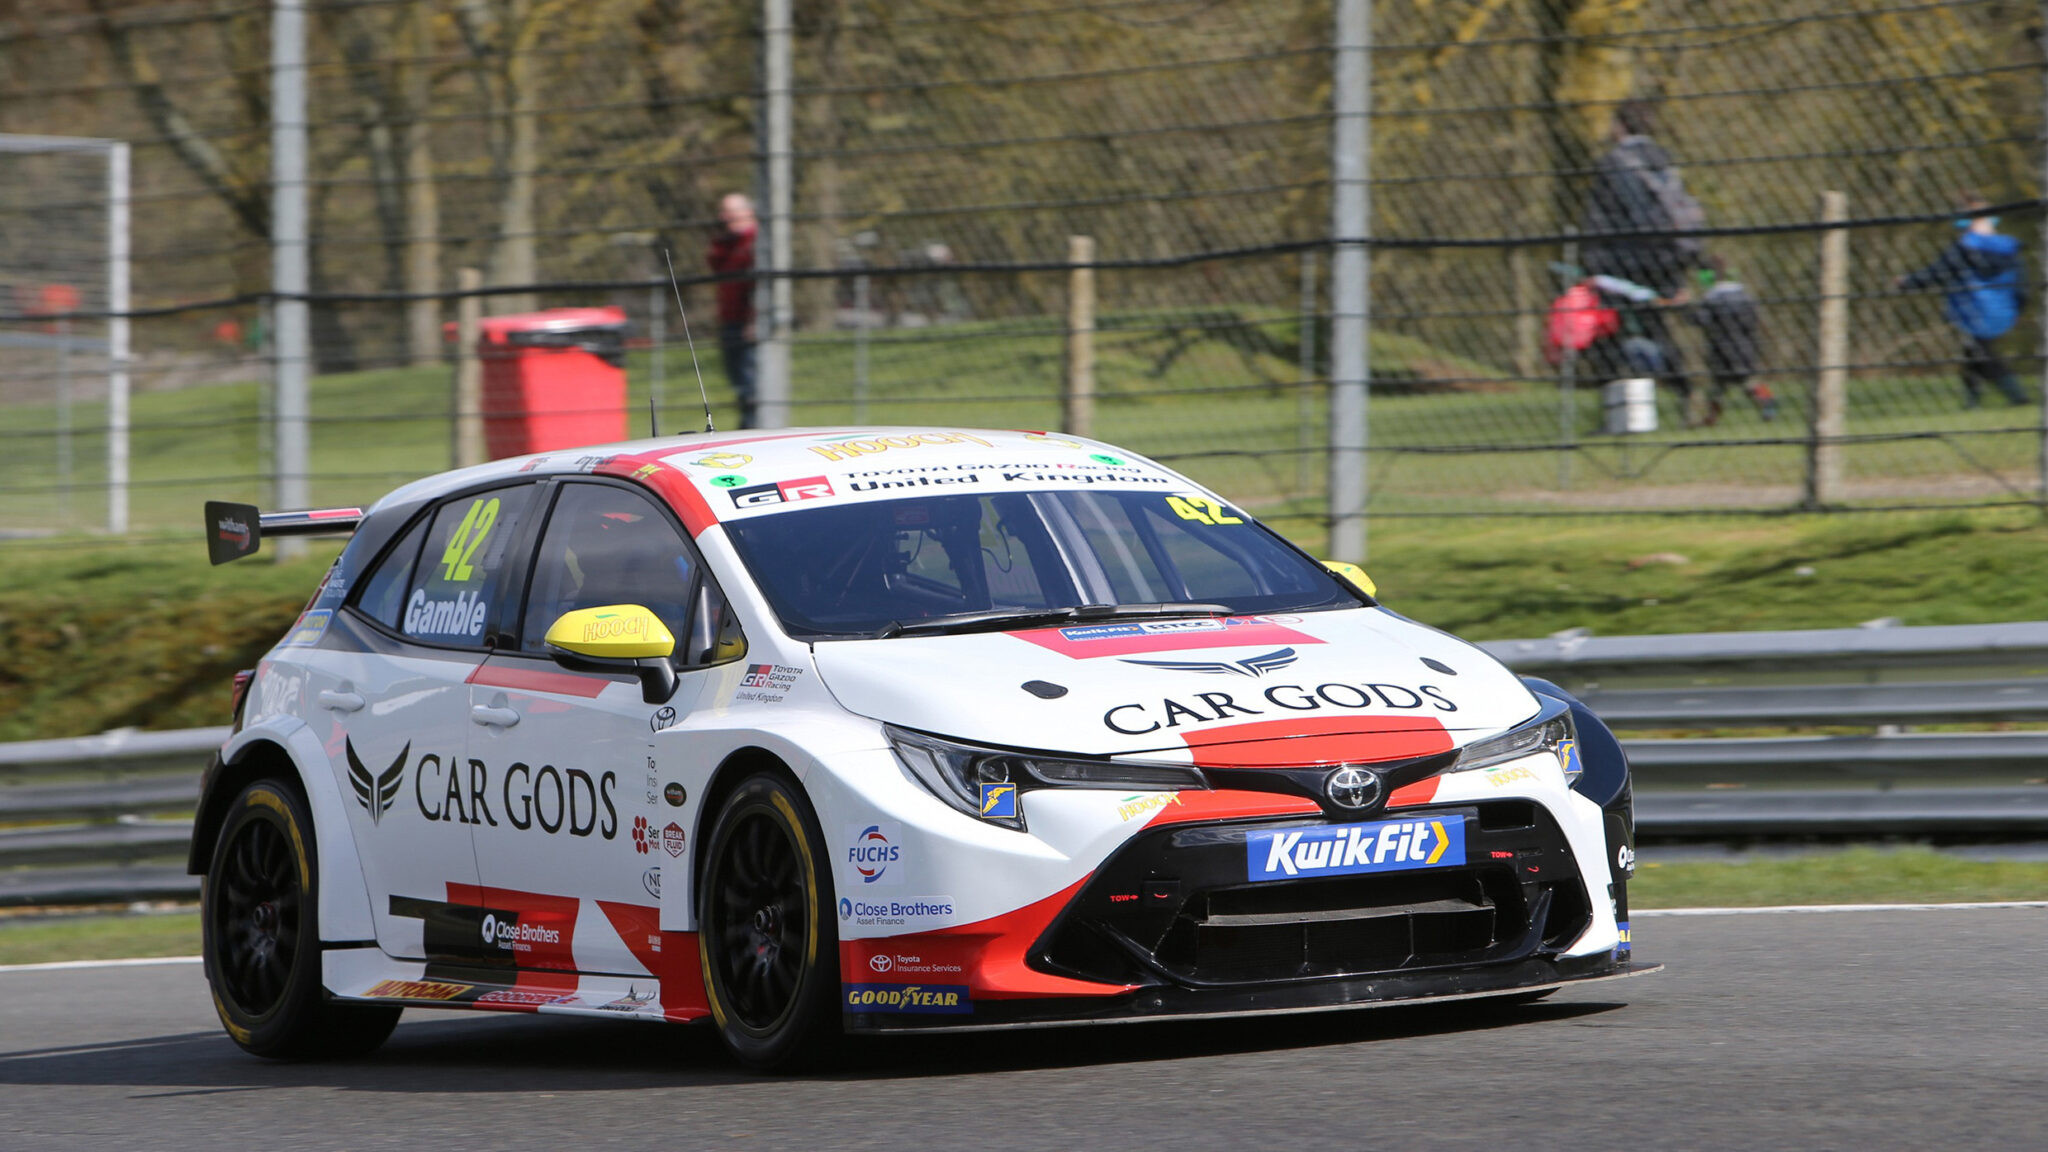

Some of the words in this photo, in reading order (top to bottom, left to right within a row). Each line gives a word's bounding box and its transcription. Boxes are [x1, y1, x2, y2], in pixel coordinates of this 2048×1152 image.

[808, 432, 994, 461] HOOCH
[842, 464, 949, 479] TOYOTA
[956, 462, 1050, 471] GAZOO
[1056, 463, 1141, 474] Racing
[849, 474, 980, 492] United
[1003, 472, 1168, 484] Kingdom
[735, 482, 834, 509] GR
[1165, 496, 1242, 525] 42
[441, 498, 500, 581] 42
[404, 588, 486, 636] Gamble
[583, 616, 649, 642] HOOCH
[769, 673, 796, 682] GAZOO
[773, 665, 804, 675] TOYOTA
[765, 681, 792, 692] Racing
[1104, 692, 1264, 735] CAR
[1264, 683, 1458, 712] GODS
[415, 753, 498, 827] CAR
[503, 762, 618, 840] GODS
[1118, 791, 1182, 822] HOOCH
[849, 846, 899, 862] FUCHS
[1110, 894, 1130, 902] TOW
[855, 902, 888, 917] Close
[891, 902, 953, 917] Brothers
[856, 917, 875, 925] Asset
[876, 917, 905, 925] Finance
[496, 921, 520, 940] Close
[522, 923, 559, 944] Brothers
[897, 955, 920, 965] Toyota
[897, 964, 931, 973] Insurance
[932, 964, 962, 973] Services
[367, 981, 461, 1000] AUTOCAR
